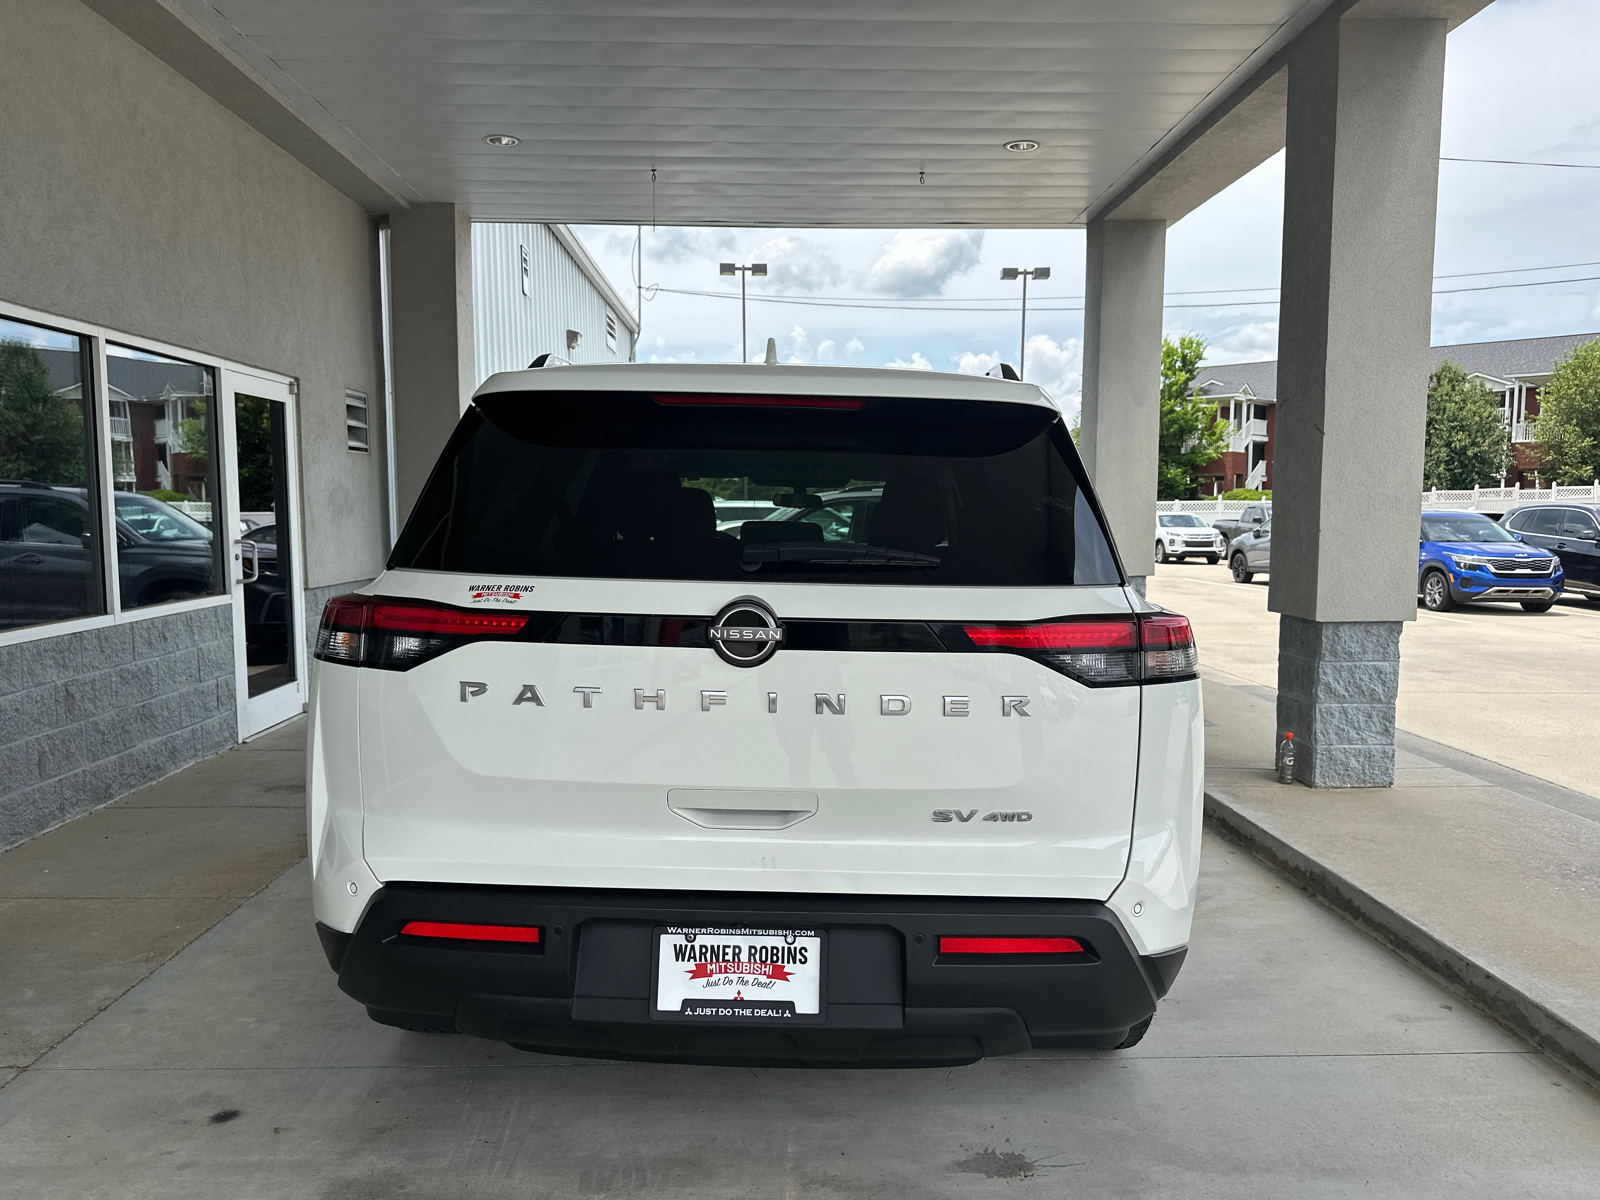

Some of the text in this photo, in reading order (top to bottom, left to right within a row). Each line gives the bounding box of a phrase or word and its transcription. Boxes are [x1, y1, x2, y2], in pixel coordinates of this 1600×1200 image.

[710, 628, 781, 640] NISSAN
[458, 679, 1033, 719] PATHFINDER
[931, 808, 1034, 823] SV 4WD
[673, 943, 809, 965] WARNER ROBINS
[706, 962, 773, 976] MITSUBISHI
[702, 975, 777, 990] Just Do The Deal!
[693, 1007, 782, 1018] JUST DO THE DEAL!
